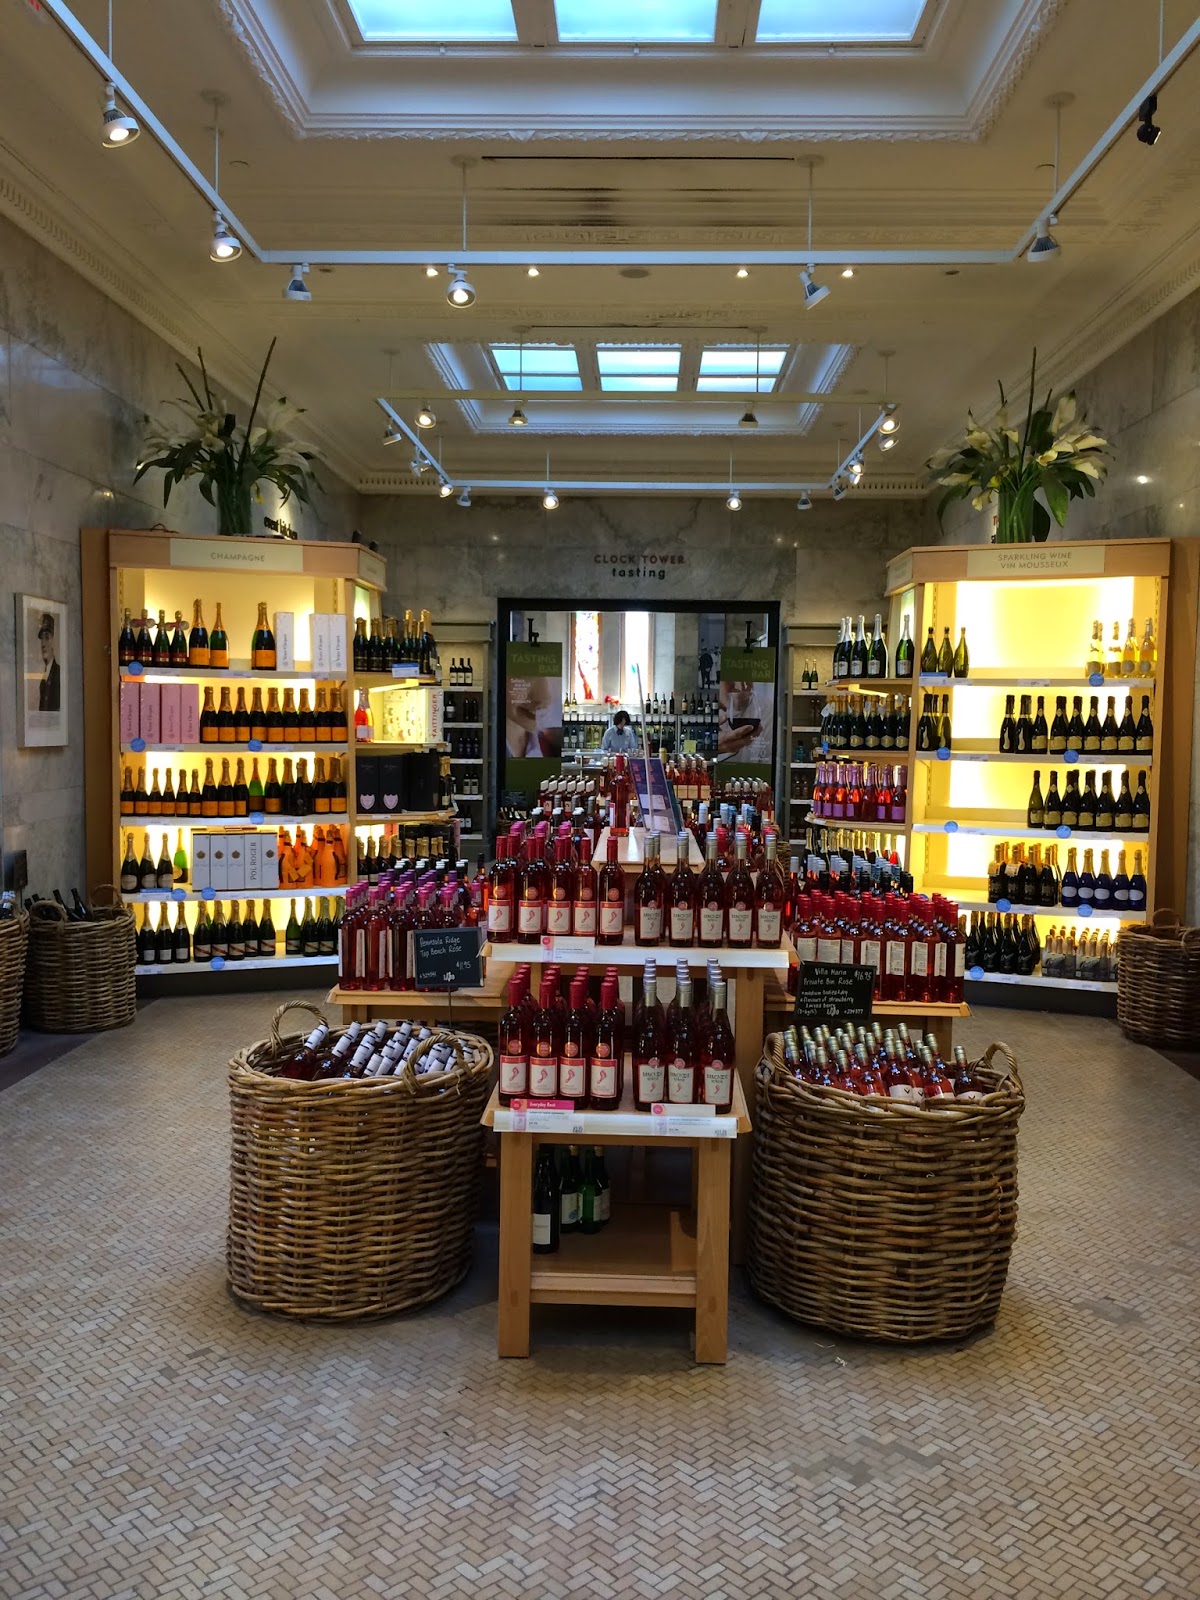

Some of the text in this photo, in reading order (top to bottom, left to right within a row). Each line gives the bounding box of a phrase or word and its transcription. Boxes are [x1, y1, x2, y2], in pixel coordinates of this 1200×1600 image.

[210, 552, 265, 562] CHAMPAGNE
[593, 555, 685, 564] CLOCK TOWER
[998, 553, 1046, 561] SPARKLING
[1018, 560, 1069, 568] MOUSSEUX
[612, 567, 666, 580] tasting
[511, 653, 557, 663] TASTING
[538, 664, 560, 673] BAR
[723, 660, 769, 669] TASTING
[751, 670, 771, 679] BAR
[445, 936, 460, 946] Ridge
[420, 950, 429, 958] Top
[430, 947, 446, 955] Bench
[854, 970, 872, 981] $16.95
